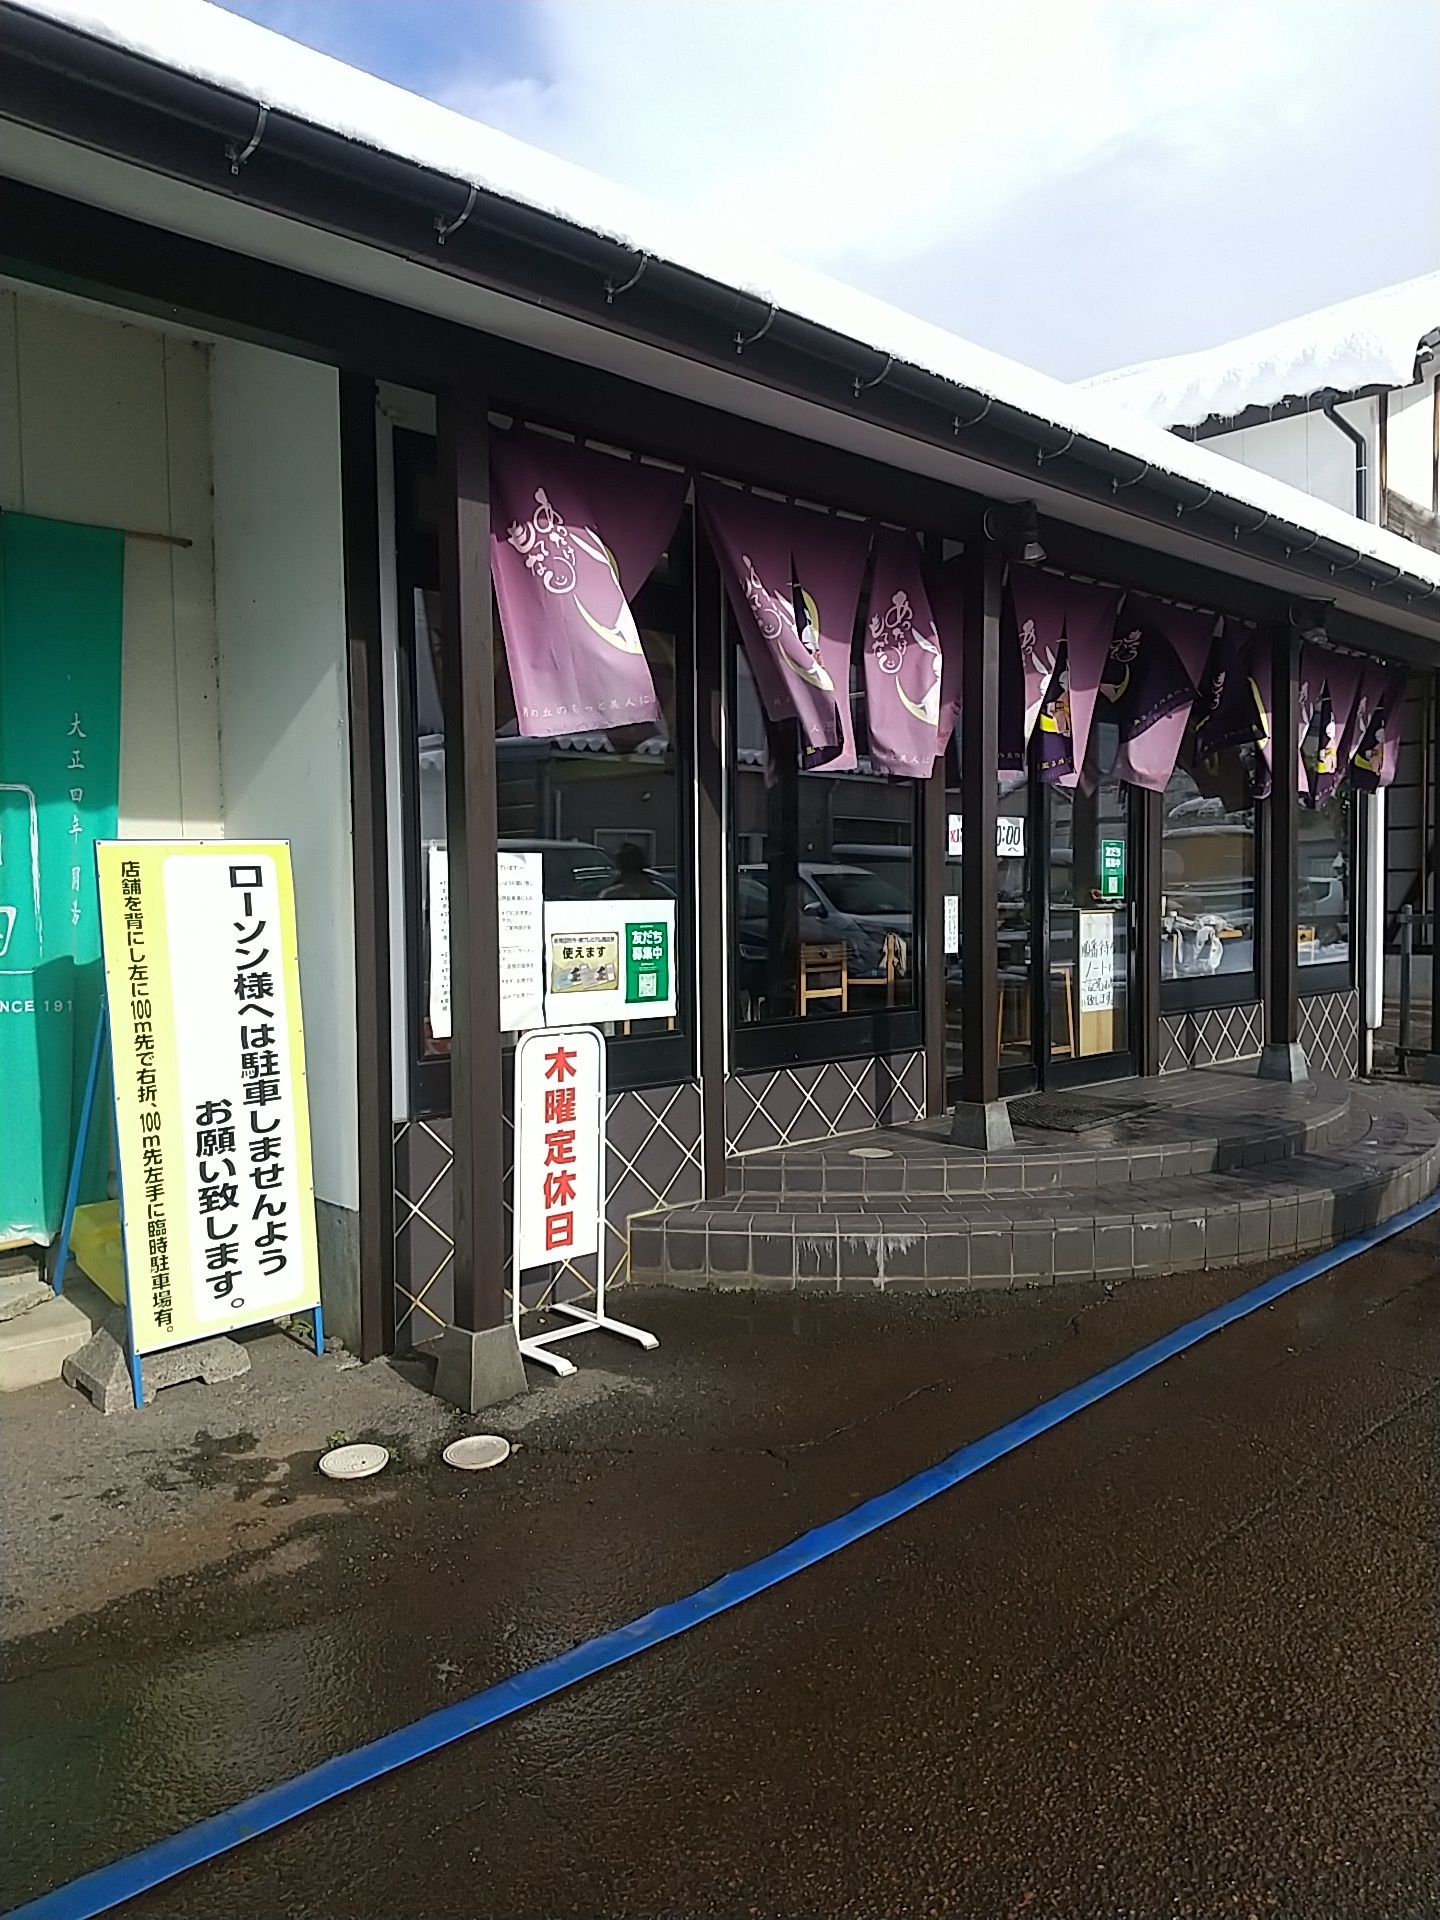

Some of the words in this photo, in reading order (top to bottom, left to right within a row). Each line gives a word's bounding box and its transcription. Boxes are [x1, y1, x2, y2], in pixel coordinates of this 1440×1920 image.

[562, 946, 606, 960] 使えます
[631, 930, 663, 945] 友だち
[229, 864, 289, 1277] ローソン様へは駐車しませんよう
[543, 1046, 578, 1251] 木曜定休日
[195, 1098, 245, 1309] お願い致します。
